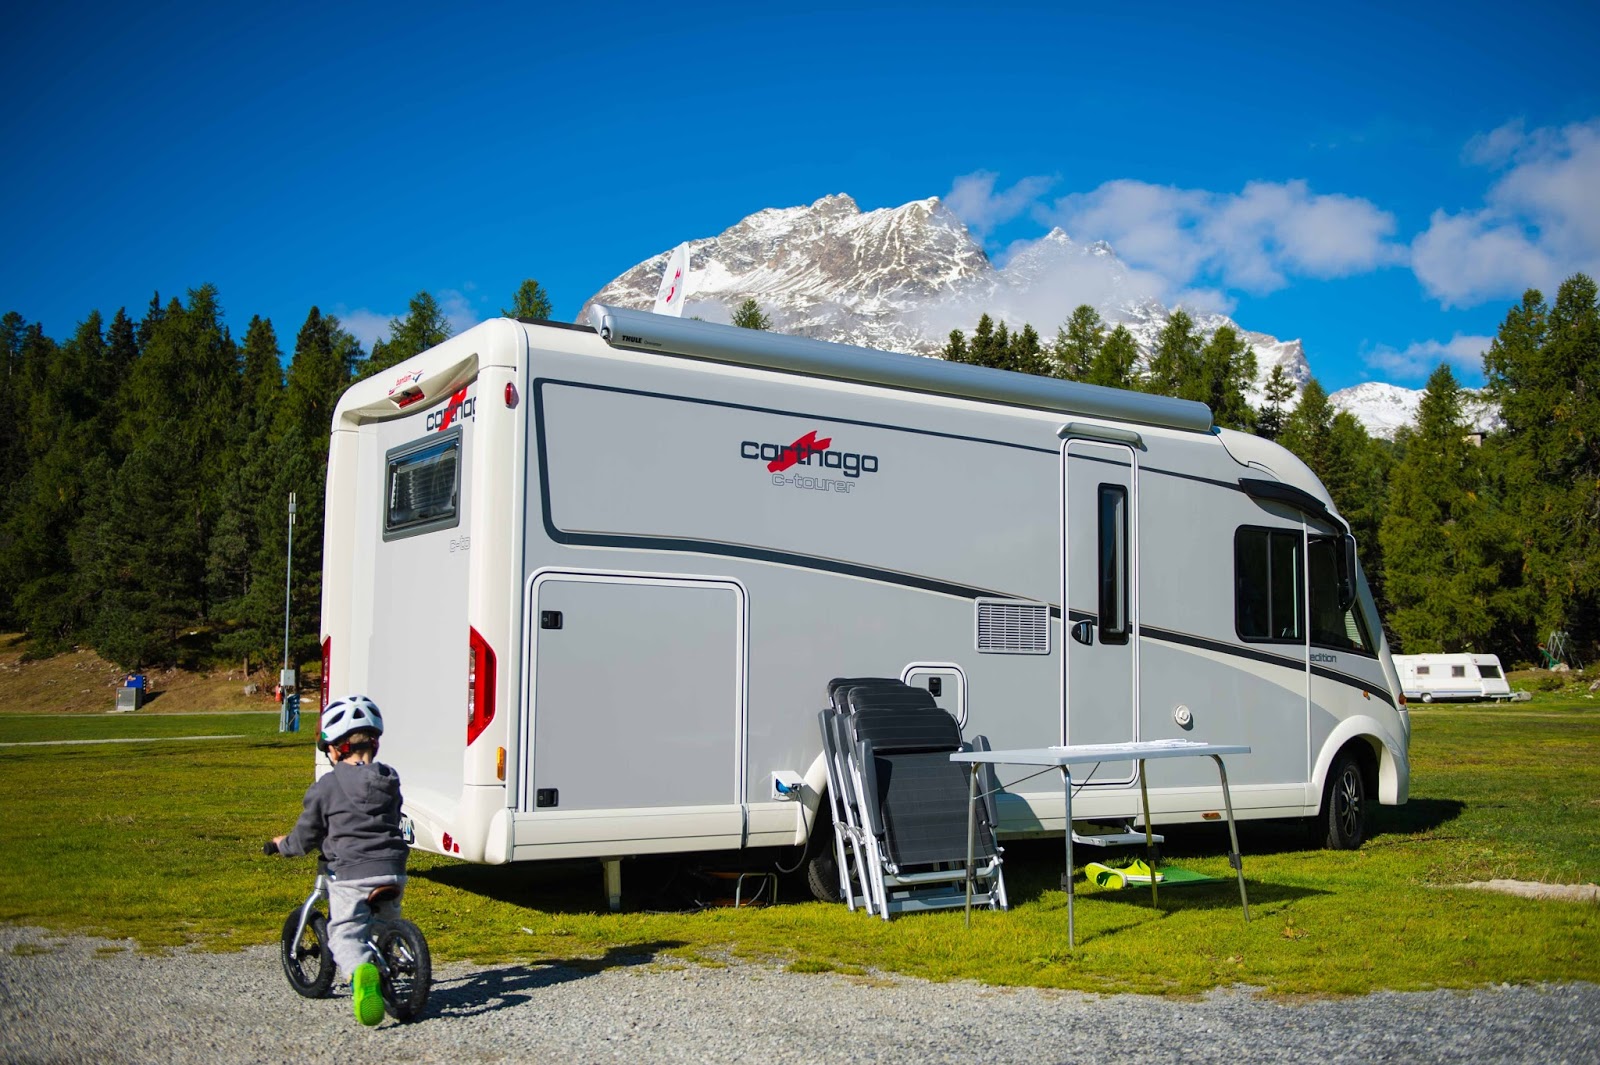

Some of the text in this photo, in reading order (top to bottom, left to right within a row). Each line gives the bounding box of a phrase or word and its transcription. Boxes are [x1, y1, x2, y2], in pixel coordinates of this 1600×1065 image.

[622, 335, 642, 344] THULE
[427, 396, 476, 431] cartha
[741, 440, 878, 478] carthago
[772, 473, 855, 493] c-tourer
[450, 535, 470, 552] c-to
[1310, 653, 1337, 663] edition
